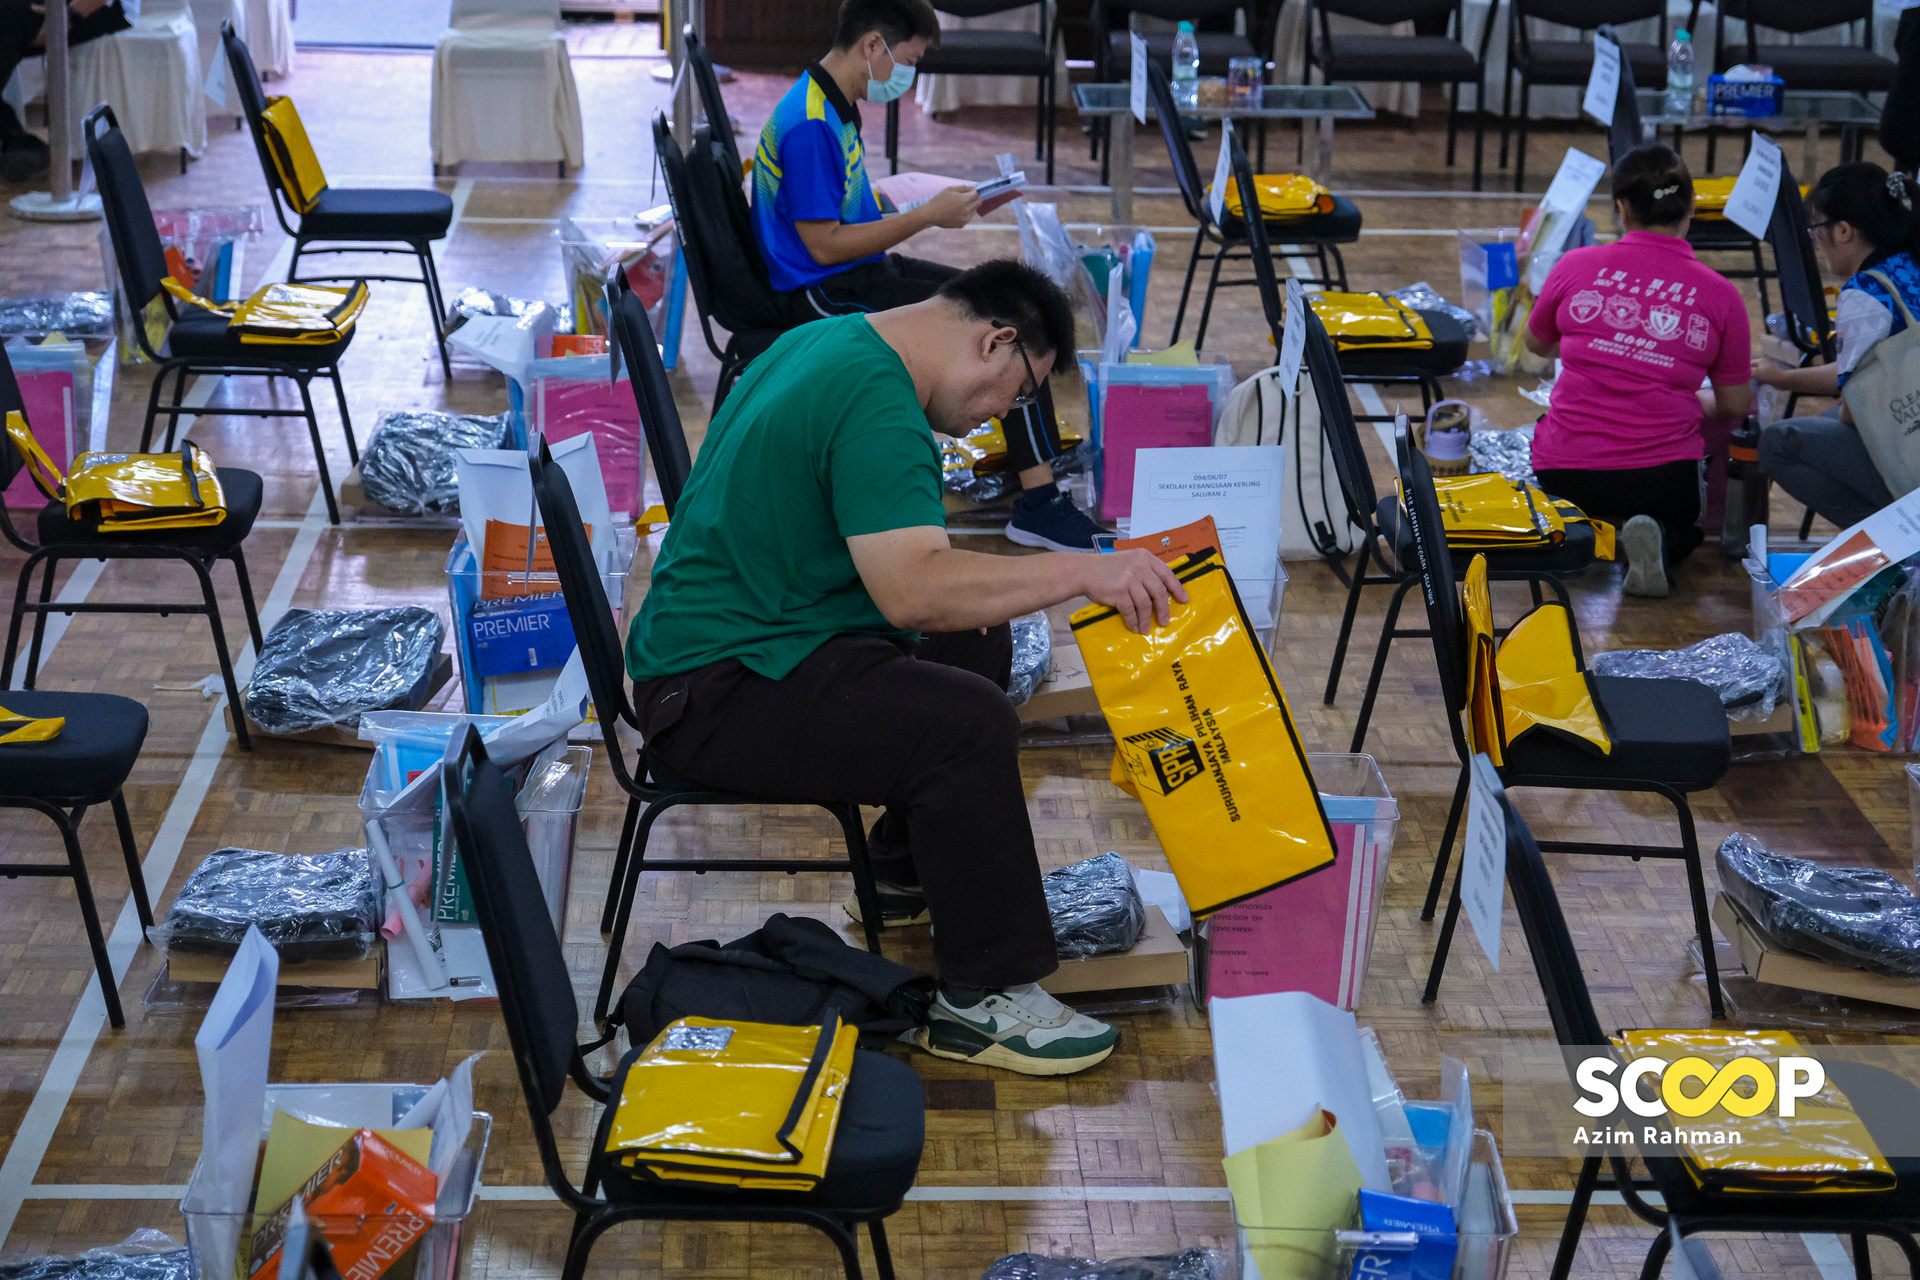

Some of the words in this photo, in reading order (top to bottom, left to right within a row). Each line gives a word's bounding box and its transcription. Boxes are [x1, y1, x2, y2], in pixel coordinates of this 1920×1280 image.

[1715, 83, 1775, 99] PREMIER
[1188, 481, 1233, 490] KEBANGSAAN
[1233, 480, 1261, 488] KERLING
[1193, 474, 1228, 482] 094/06/07
[473, 613, 551, 638] PREMIER
[1171, 660, 1189, 692] RAYA
[1183, 694, 1208, 738] PILIHAN
[1201, 707, 1232, 765] MALAYSIA
[1157, 743, 1199, 789] SPR
[1202, 740, 1241, 823] SURUHANJAYA
[1384, 1218, 1440, 1233] PREMIER
